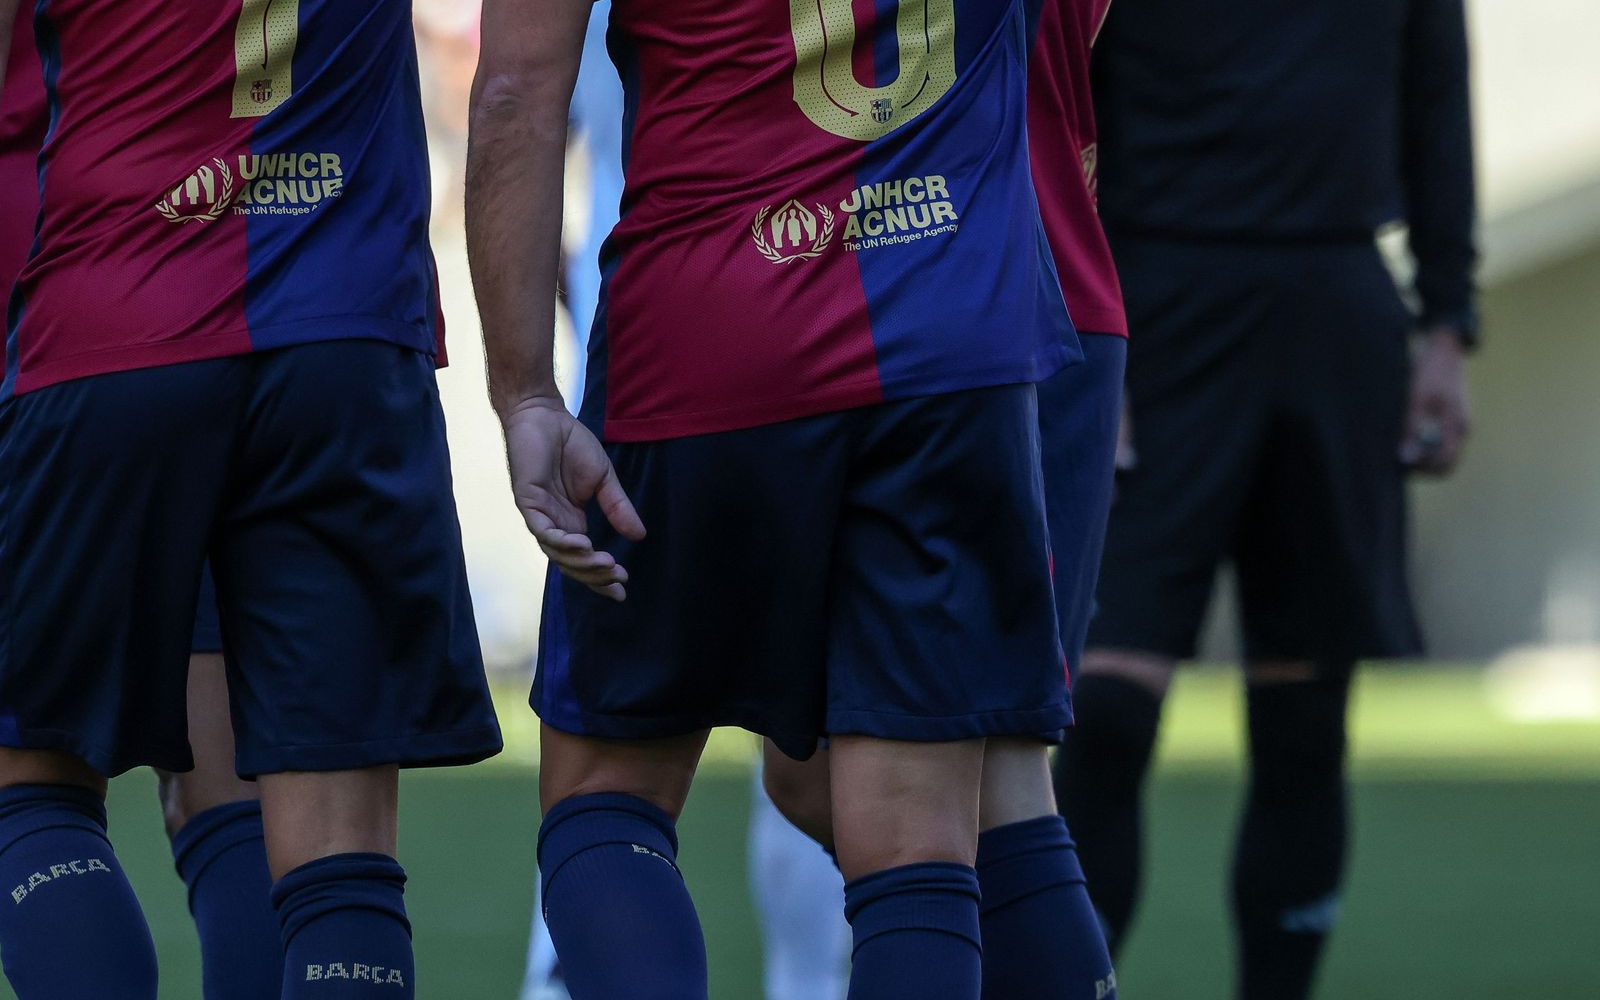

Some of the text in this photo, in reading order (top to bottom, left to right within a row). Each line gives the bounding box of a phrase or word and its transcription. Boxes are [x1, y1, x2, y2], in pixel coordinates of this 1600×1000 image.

[238, 152, 343, 180] UNHCR
[233, 177, 343, 205] ACNUR
[839, 174, 950, 213] UNHCR
[232, 206, 251, 216] The
[252, 206, 268, 215] UN
[269, 205, 310, 216] Refugee
[842, 200, 959, 240] ACNUR
[843, 223, 959, 252] The UN Refugee Agency
